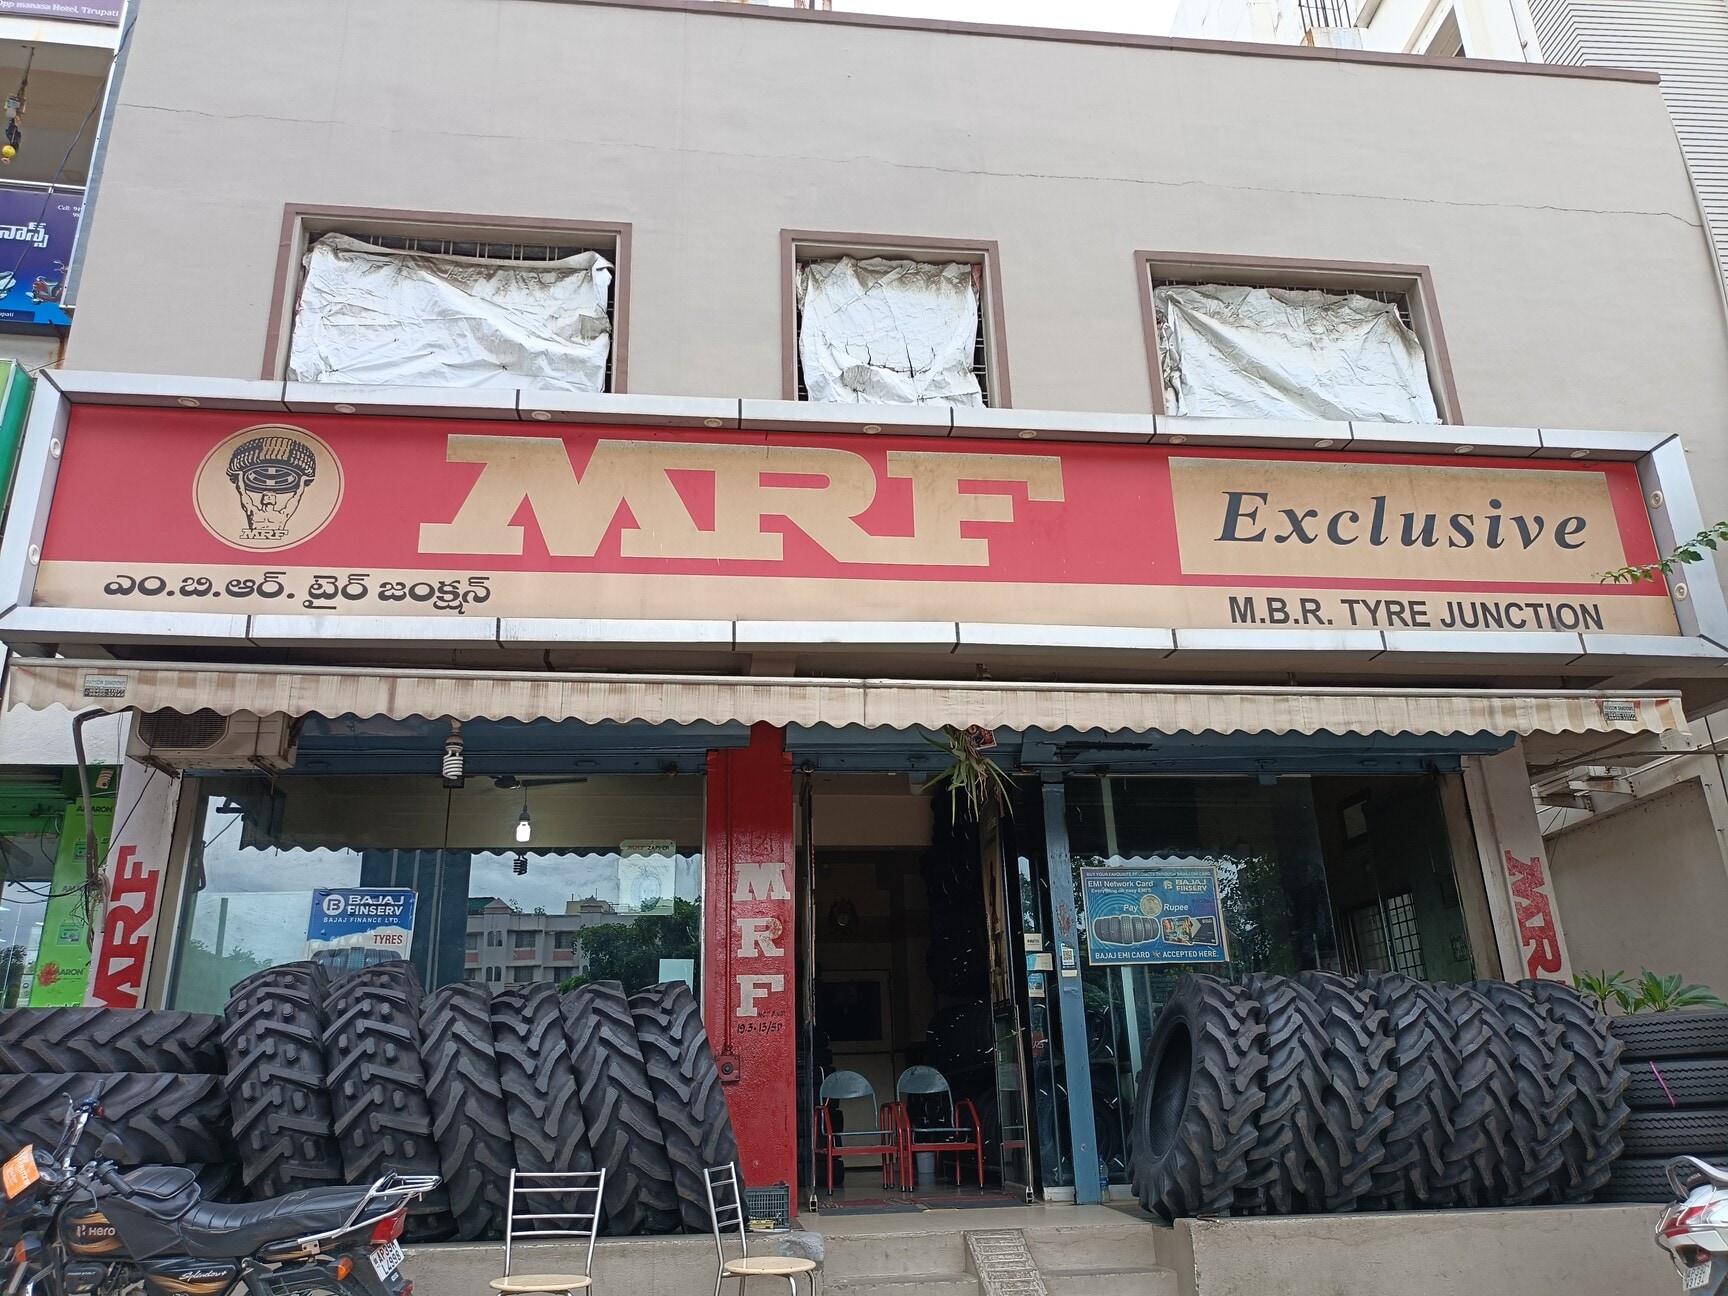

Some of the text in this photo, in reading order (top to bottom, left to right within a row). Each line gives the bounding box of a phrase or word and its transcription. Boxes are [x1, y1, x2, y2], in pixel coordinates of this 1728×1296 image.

[81, 7, 119, 16] Tirupati
[417, 432, 1065, 567] MRF
[1214, 491, 1587, 550] Exclusive
[239, 528, 289, 541] MRF
[1228, 596, 1605, 631] M.B.R. TYRE JUNCTION
[1088, 880, 1102, 888] EMI
[1104, 880, 1134, 888] Network
[348, 895, 405, 905] BAJAJ
[347, 906, 404, 916] FINSERV
[1123, 904, 1138, 912] Pay
[1163, 903, 1189, 912] Rupee
[1504, 850, 1567, 986] MR
[93, 845, 160, 1009] MRF
[373, 934, 403, 945] TYRES
[732, 862, 791, 1017] MRF
[1095, 951, 1117, 959] BAJAJ
[1118, 951, 1131, 959] EMI
[1163, 950, 1198, 958] ACCEPTED
[88, 1227, 116, 1236] Hero
